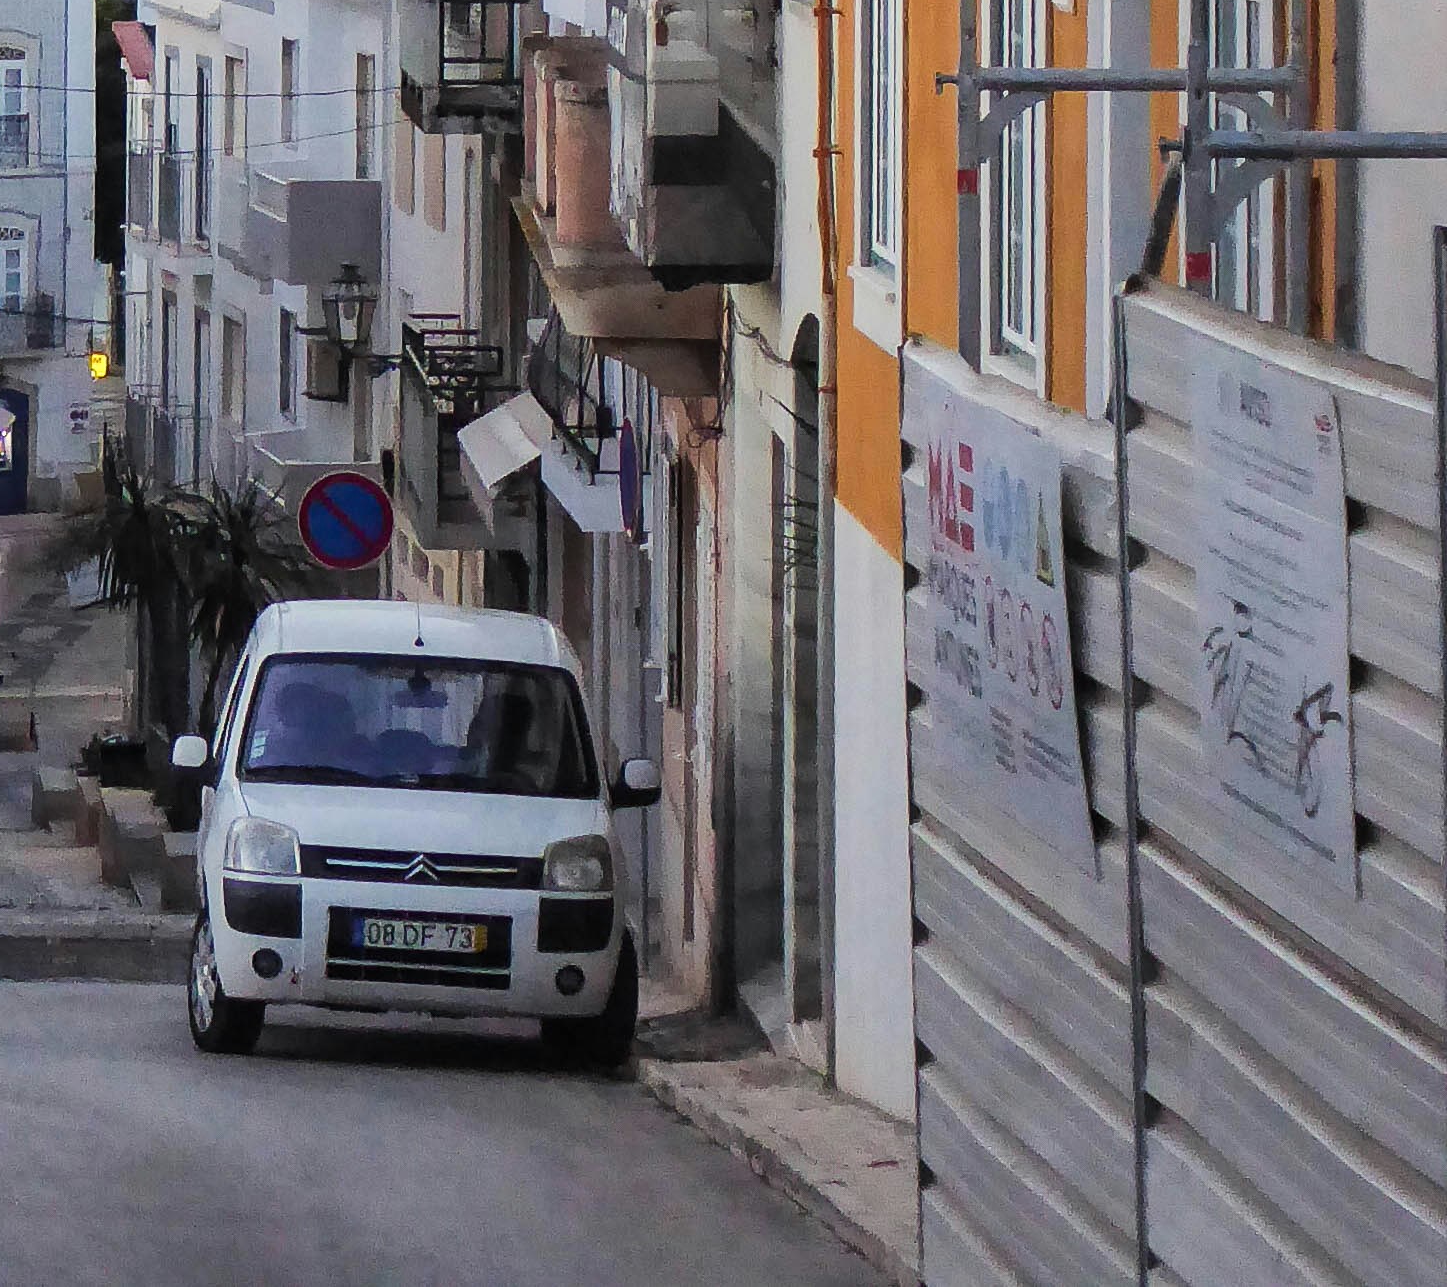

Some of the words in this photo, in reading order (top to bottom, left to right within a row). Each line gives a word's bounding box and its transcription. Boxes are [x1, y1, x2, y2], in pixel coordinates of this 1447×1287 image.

[366, 922, 395, 946] 08
[403, 924, 436, 947] DF
[445, 925, 473, 949] 73
